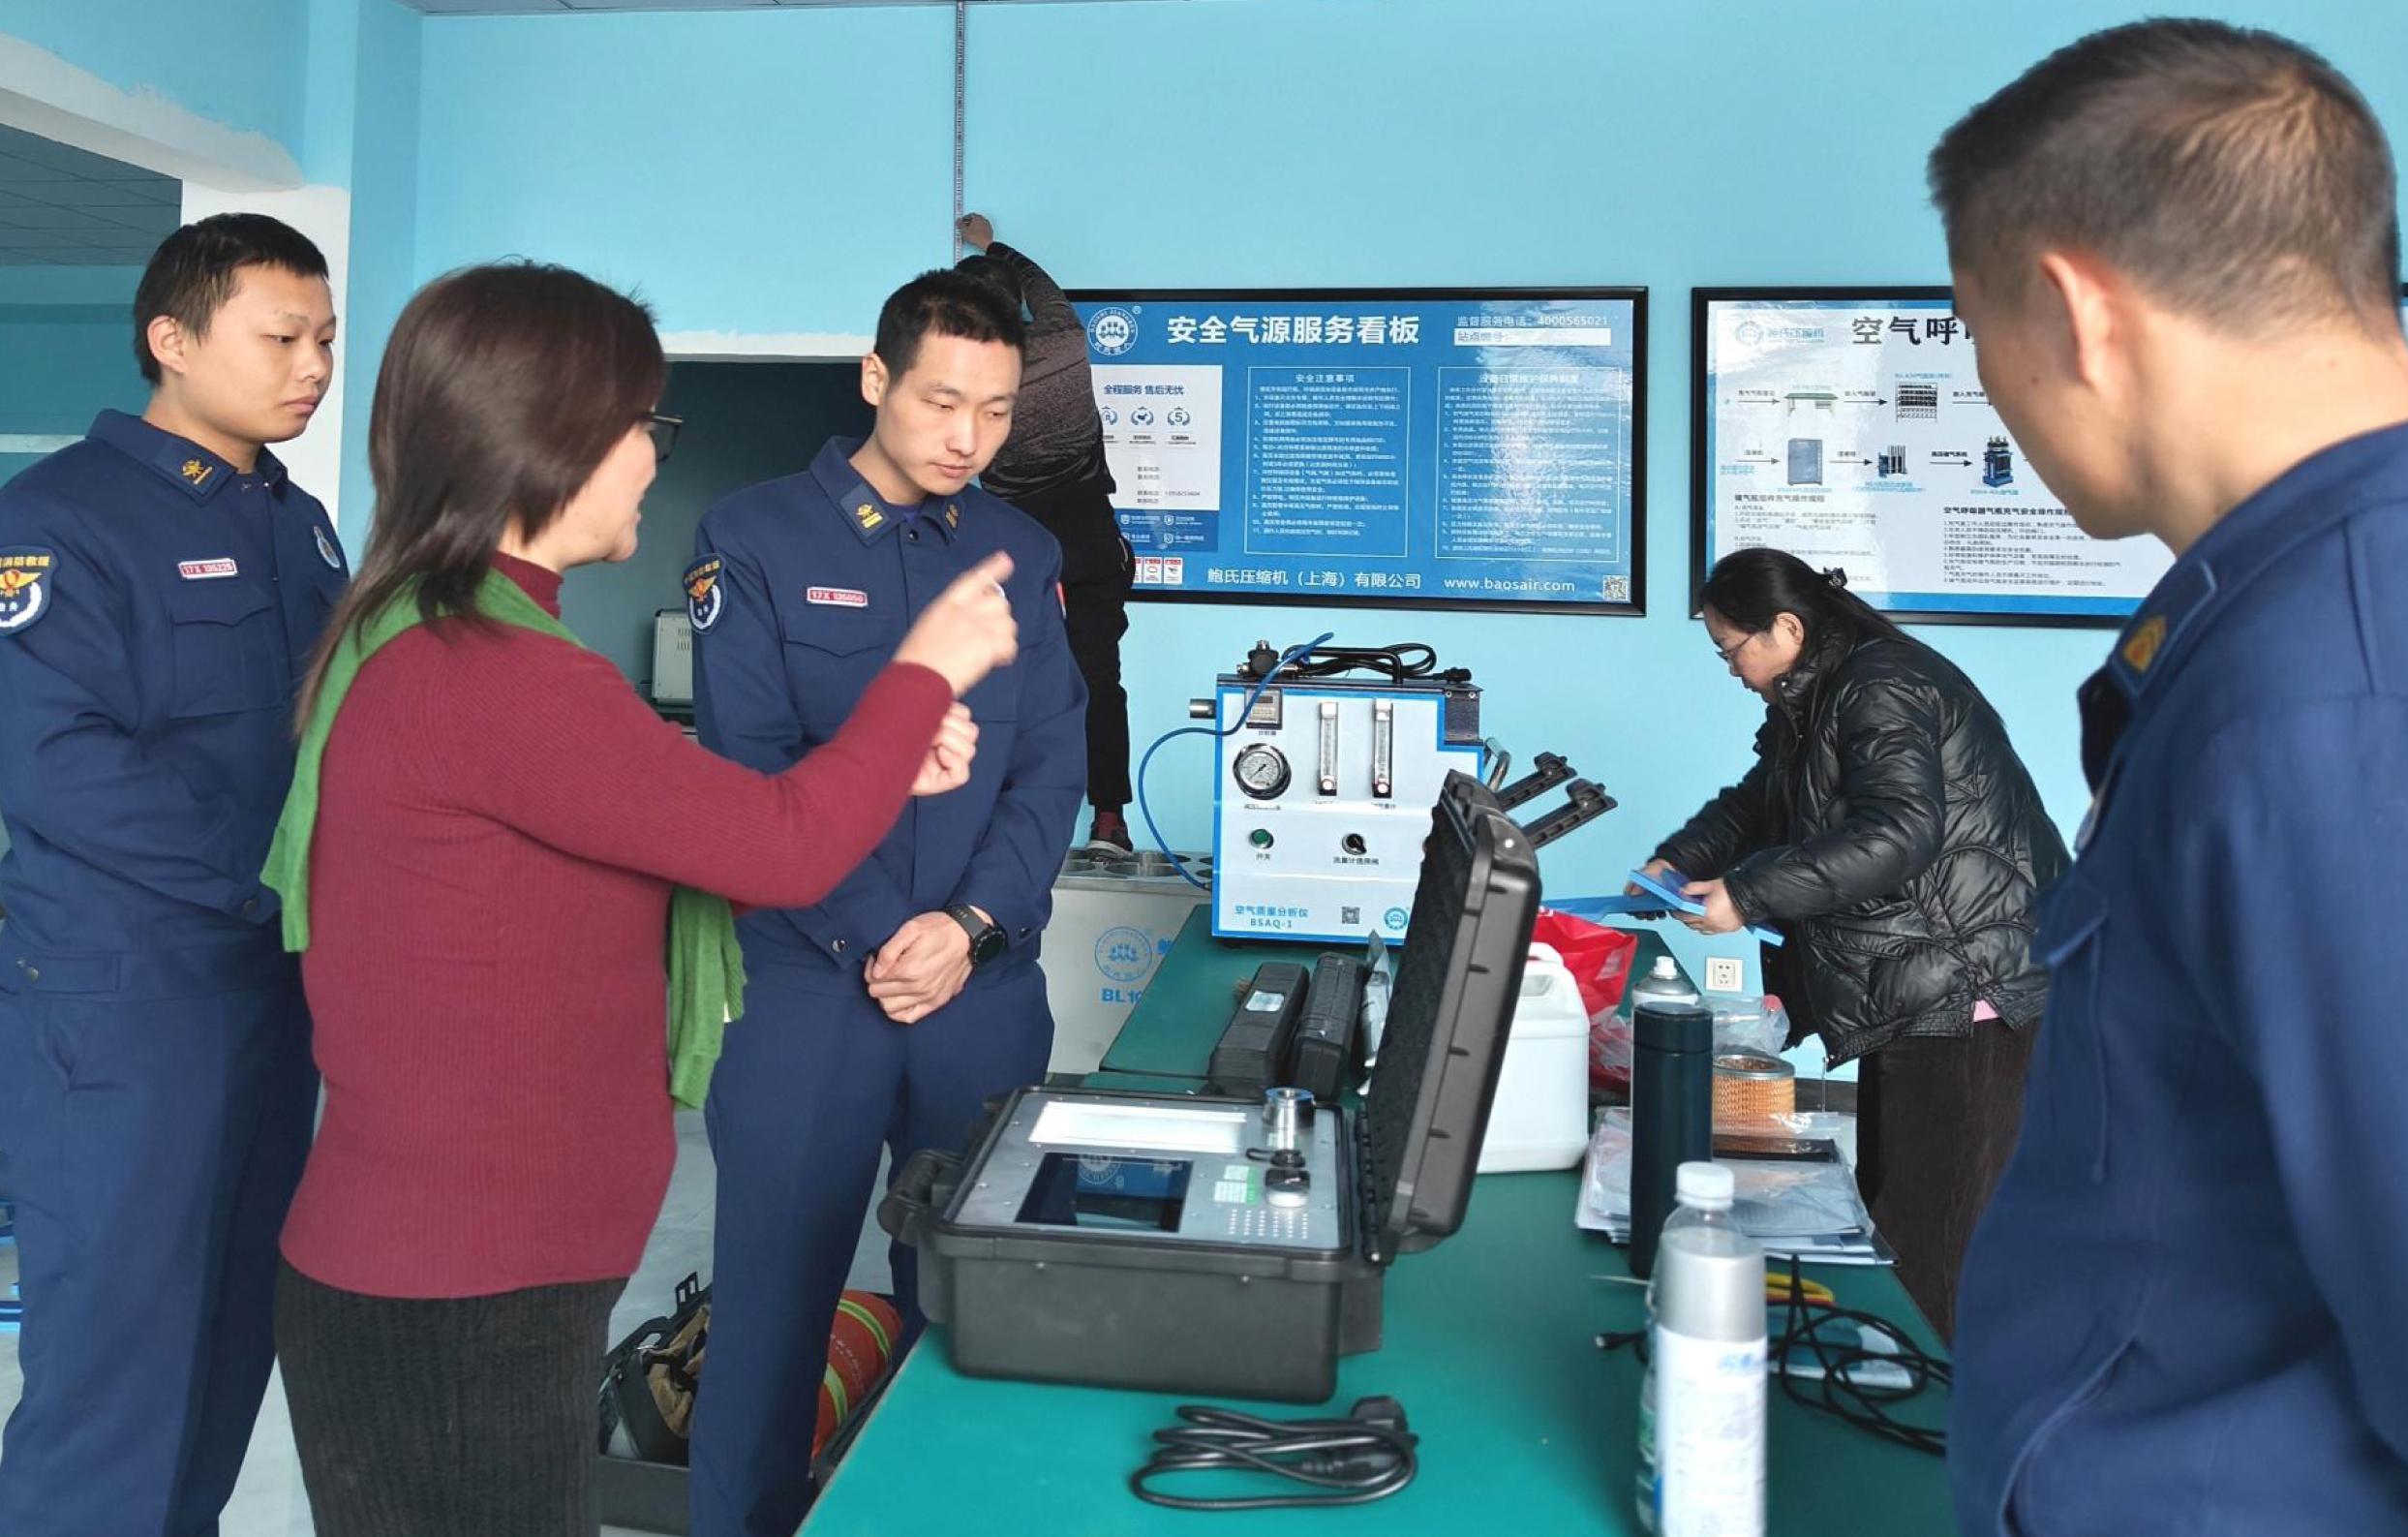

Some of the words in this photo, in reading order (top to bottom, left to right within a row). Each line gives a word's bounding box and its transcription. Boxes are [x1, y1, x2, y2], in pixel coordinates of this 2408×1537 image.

[1167, 315, 1419, 344] 安全气源服务看板
[1104, 384, 1142, 395] 全程服务
[1144, 384, 1184, 395] 售后无忧
[1174, 412, 1183, 423] 5
[1206, 568, 1422, 590] 鲍氏压缩机（上海）有限公司
[1443, 576, 1576, 593] www.baosair.com
[1234, 906, 1309, 918] 空气质量分析仪
[1250, 919, 1293, 929] BSAQ-1
